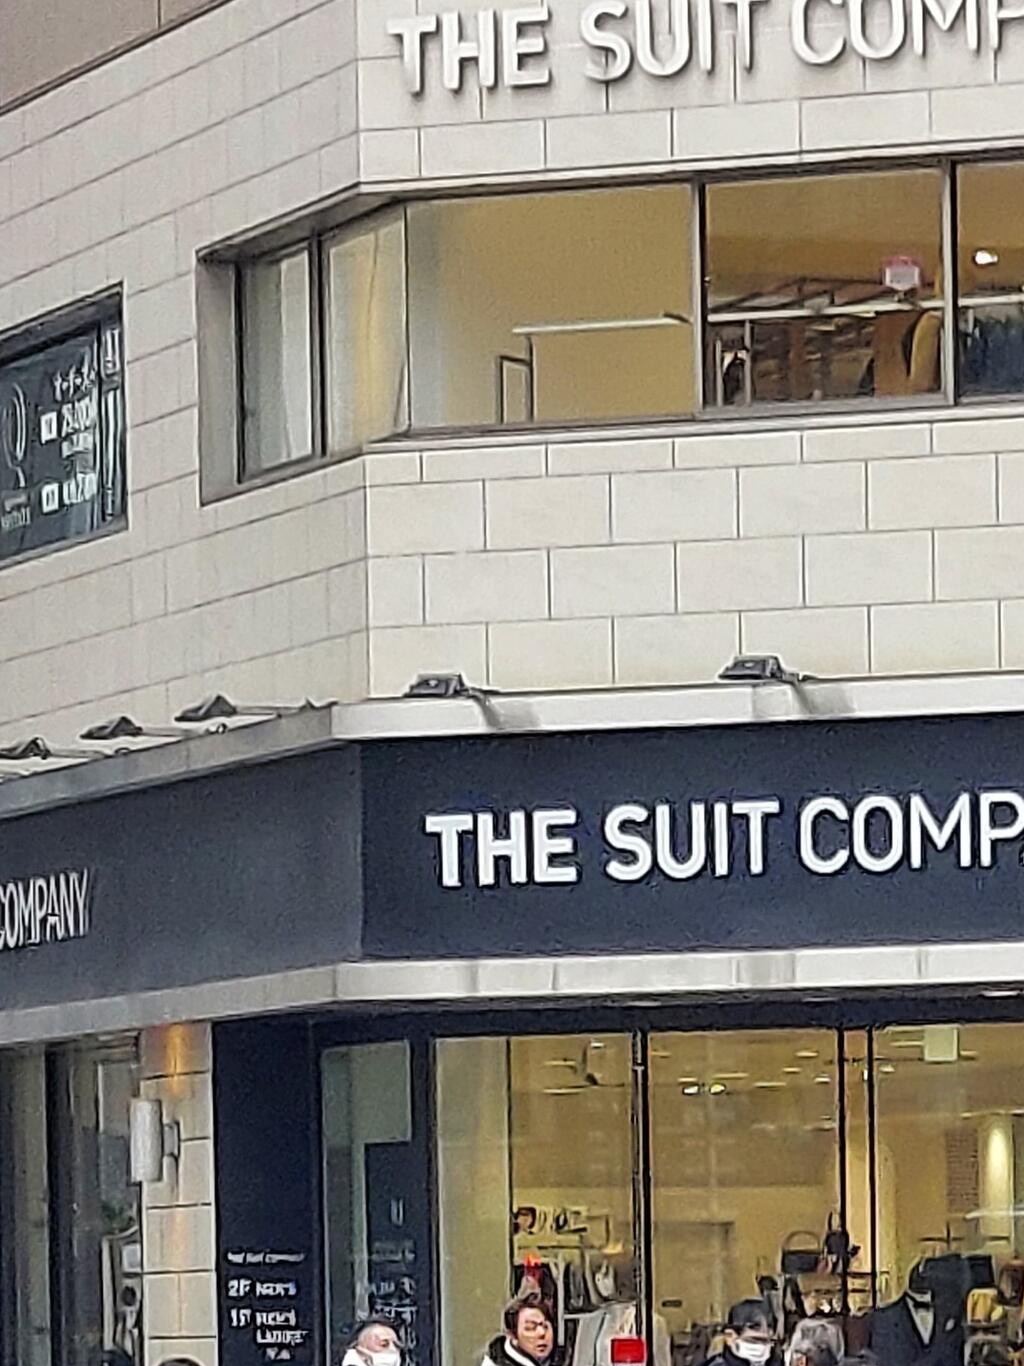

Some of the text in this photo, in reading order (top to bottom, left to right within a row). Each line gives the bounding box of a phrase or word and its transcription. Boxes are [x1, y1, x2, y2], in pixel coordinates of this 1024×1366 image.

[387, 5, 551, 94] THE
[580, 0, 771, 82] SUIT
[425, 807, 578, 887] THE
[604, 799, 781, 881] SUIT
